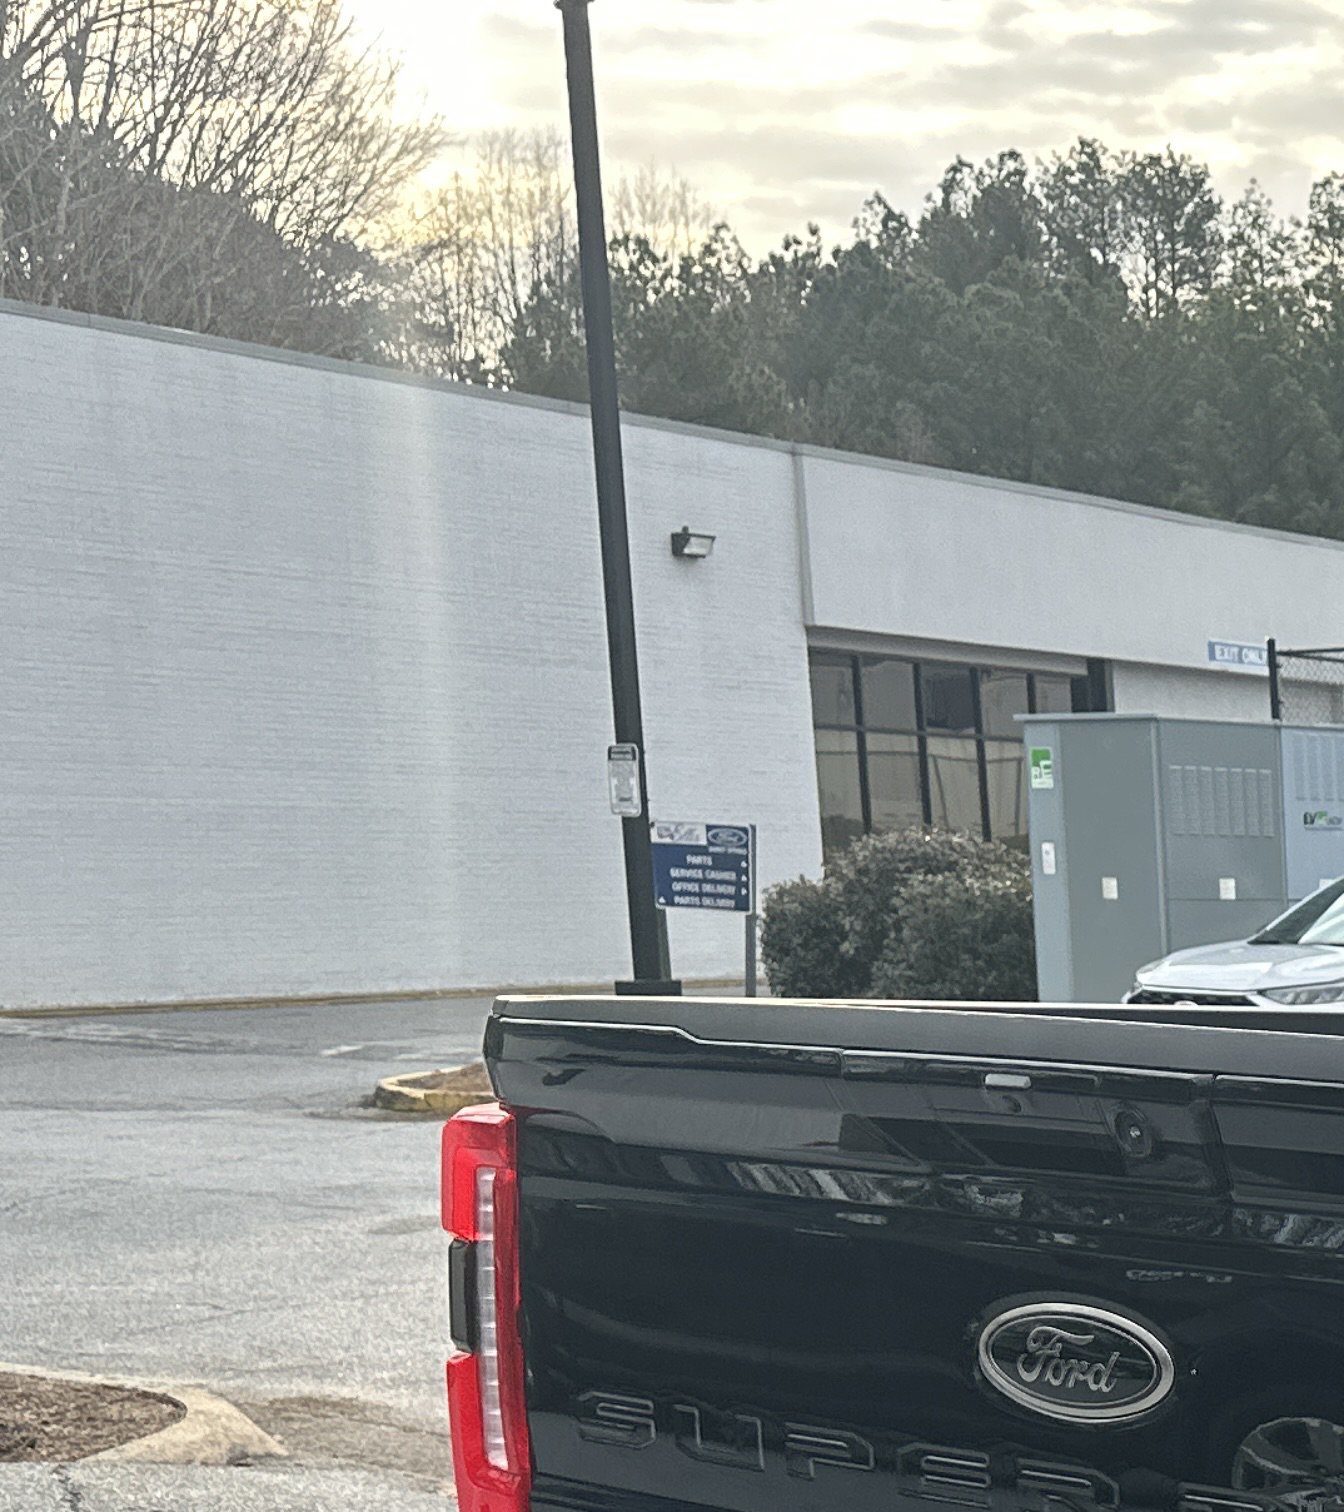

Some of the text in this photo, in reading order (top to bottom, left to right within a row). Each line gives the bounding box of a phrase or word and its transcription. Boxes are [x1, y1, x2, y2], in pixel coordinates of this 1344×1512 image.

[1214, 644, 1239, 662] EXIT
[686, 854, 712, 866] PARTS
[670, 867, 703, 879] SERVICE
[673, 896, 700, 905] PARTS
[1017, 1325, 1121, 1393] Ford
